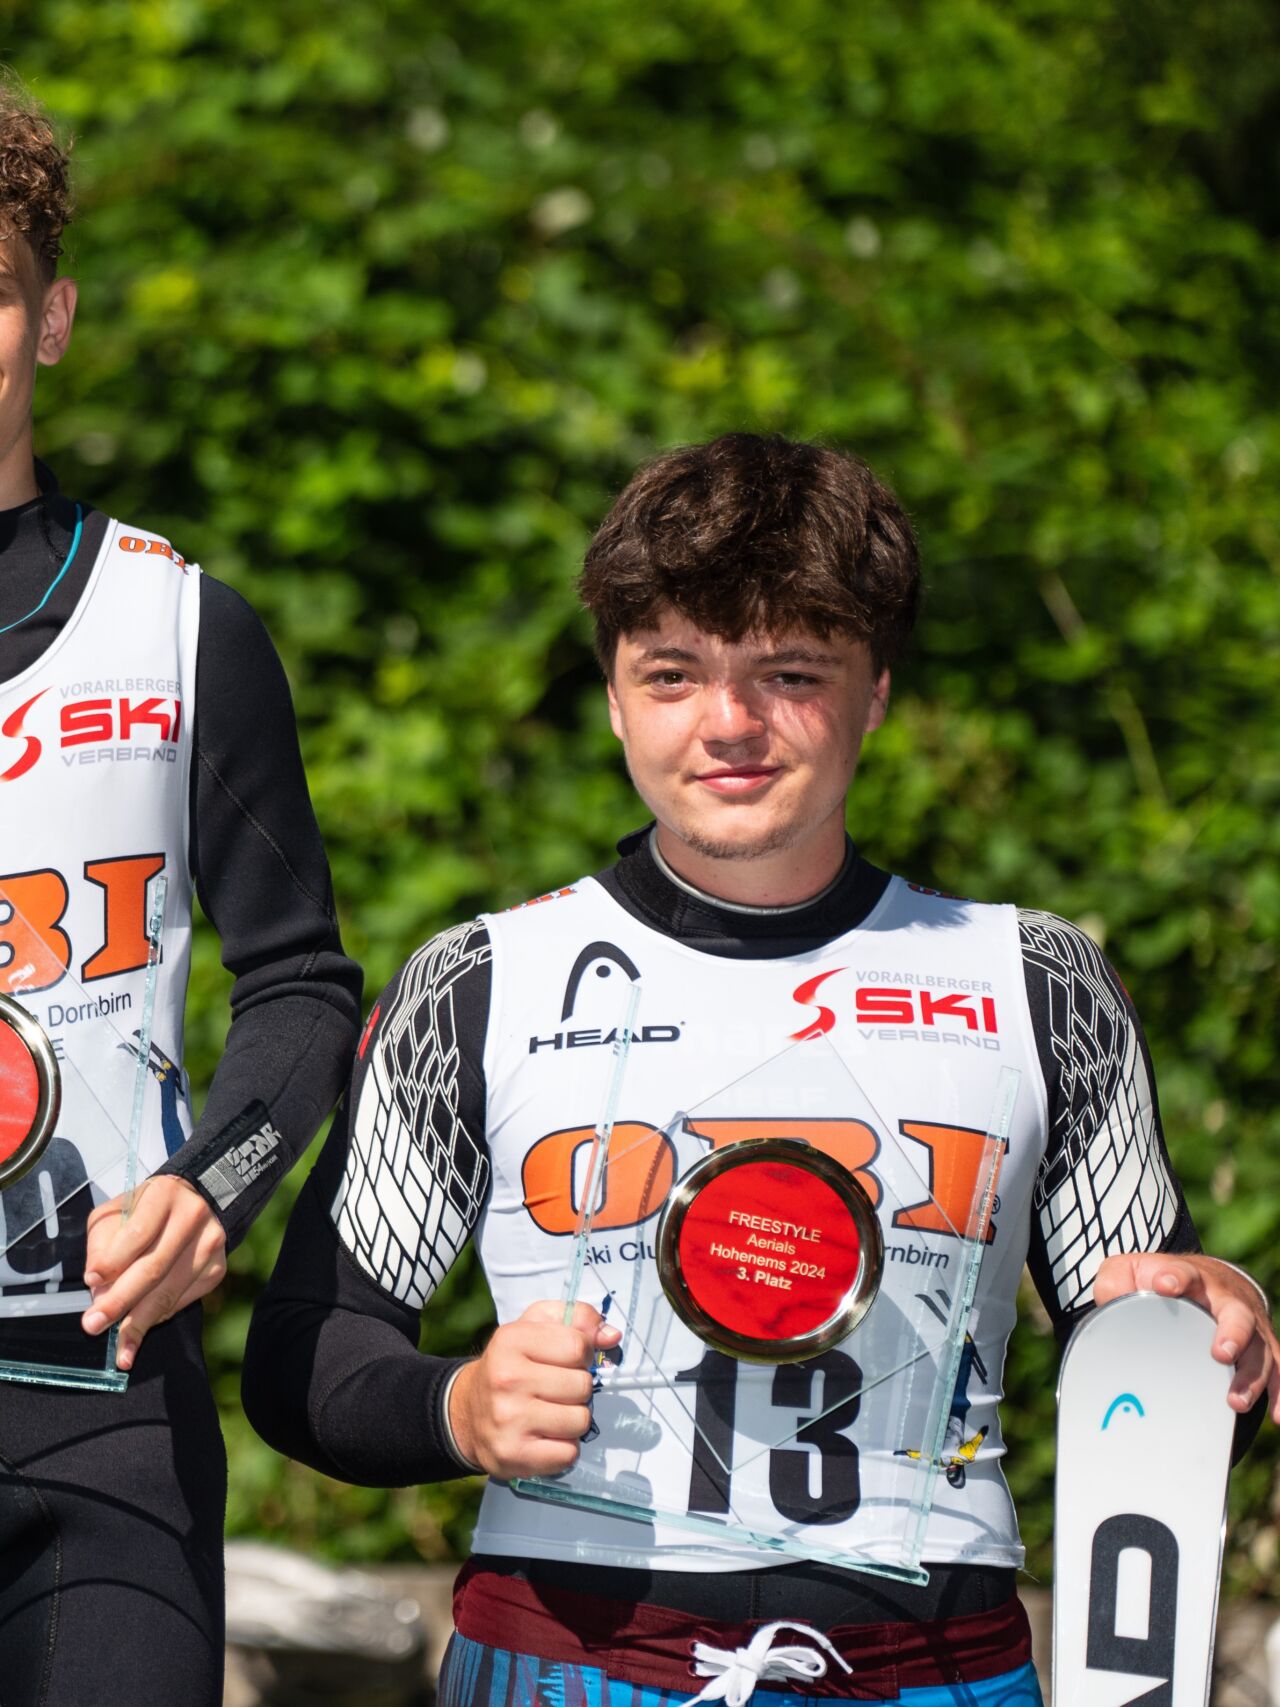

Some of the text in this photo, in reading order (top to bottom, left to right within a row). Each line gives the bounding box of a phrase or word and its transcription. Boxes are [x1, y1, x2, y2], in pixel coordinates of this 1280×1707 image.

[119, 536, 189, 575] OBI
[60, 678, 181, 700] VORARLBERGER
[60, 698, 181, 748] SKI
[61, 747, 177, 767] VERBAND
[855, 970, 993, 993] VORARLBERGER
[48, 992, 132, 1028] Dornbirn
[855, 987, 998, 1034] SKI
[528, 1025, 681, 1055] HEAD
[858, 1028, 1001, 1051] VERBAND
[728, 1210, 822, 1243] FREESTYLE
[619, 1241, 657, 1262] Clu
[746, 1233, 797, 1255] Aerials
[710, 1242, 826, 1280] Hohenems 2024
[737, 1266, 793, 1290] 3. Platz
[674, 1344, 863, 1526] 13
